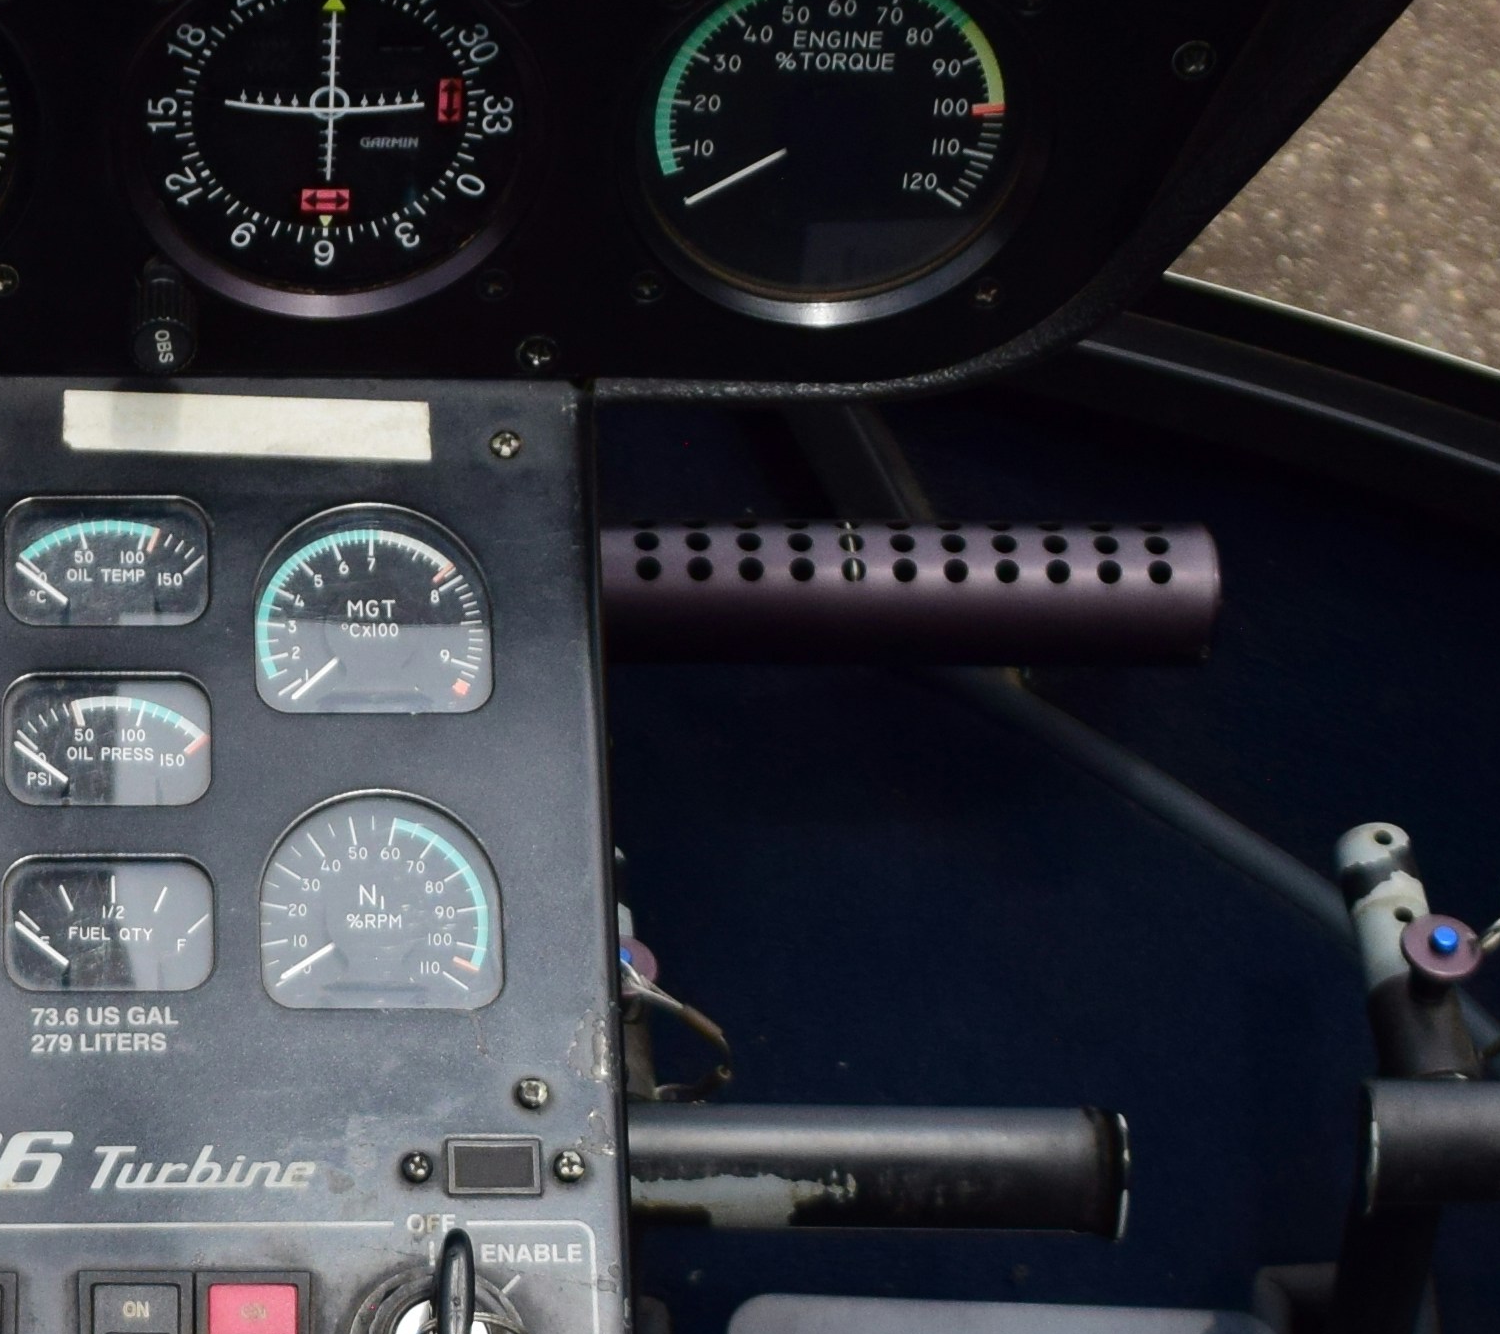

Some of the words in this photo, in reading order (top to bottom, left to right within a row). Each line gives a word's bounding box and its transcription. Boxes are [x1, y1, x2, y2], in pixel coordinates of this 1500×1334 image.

[793, 31, 884, 49] ENGINE
[360, 136, 419, 149] GARMIN
[154, 329, 174, 364] OBS
[66, 568, 93, 582] OIL
[100, 568, 145, 582] TEMP
[347, 600, 396, 618] MGT
[66, 746, 93, 761] OIL
[101, 746, 154, 761] PRESS
[102, 905, 125, 919] 1/2
[346, 914, 402, 929] %RPM
[68, 926, 111, 940] FUEL
[119, 928, 153, 941] QTY
[30, 1008, 79, 1027] 73.6
[86, 1007, 120, 1026] US
[127, 1006, 179, 1025] GAL
[31, 1033, 72, 1053] 279
[80, 1032, 167, 1052] LITERS
[89, 1143, 317, 1190] Turbine
[406, 1213, 456, 1233] OFF
[481, 1243, 582, 1264] ENABLE
[122, 1301, 150, 1319] ON
